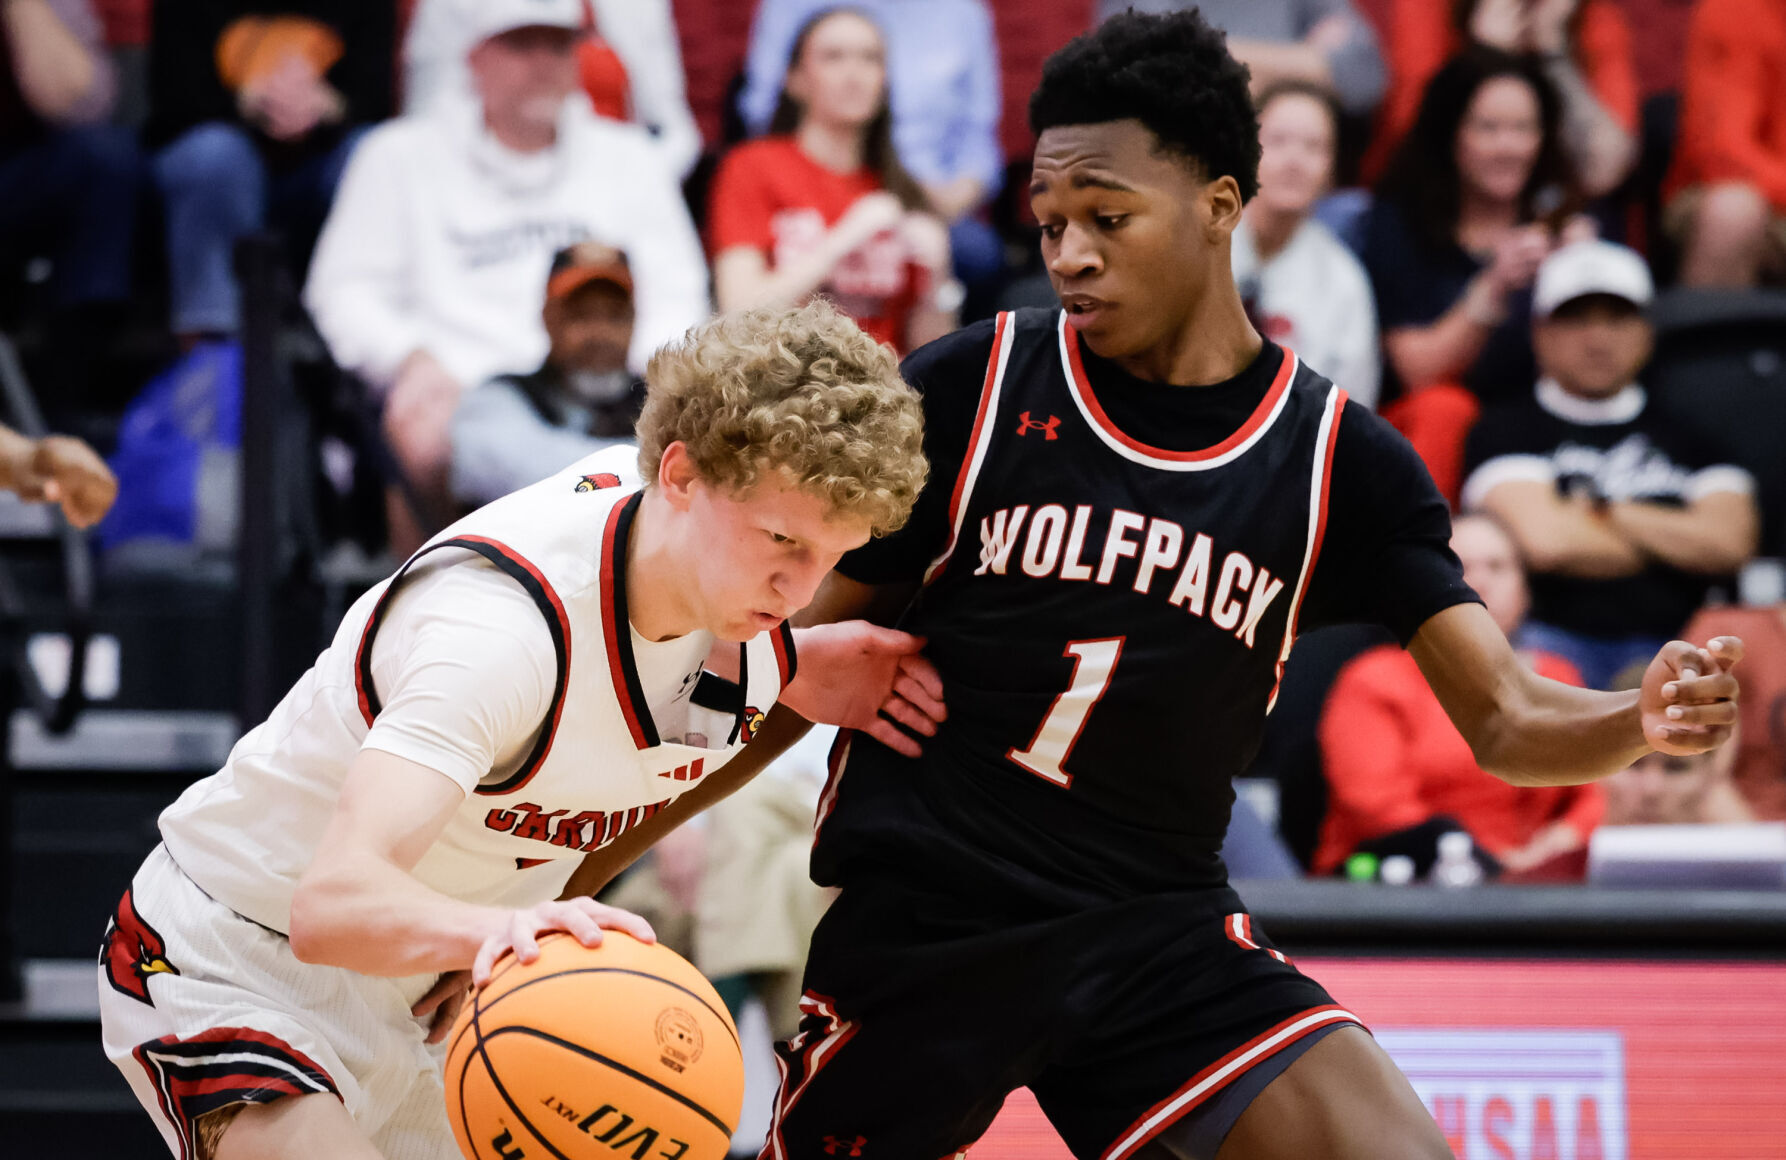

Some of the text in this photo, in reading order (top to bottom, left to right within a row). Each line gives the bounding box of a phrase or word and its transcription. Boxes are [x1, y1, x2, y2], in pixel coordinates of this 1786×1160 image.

[974, 504, 1284, 649] WOLFPACK
[1005, 635, 1127, 790] 1
[539, 1096, 580, 1122] NXT
